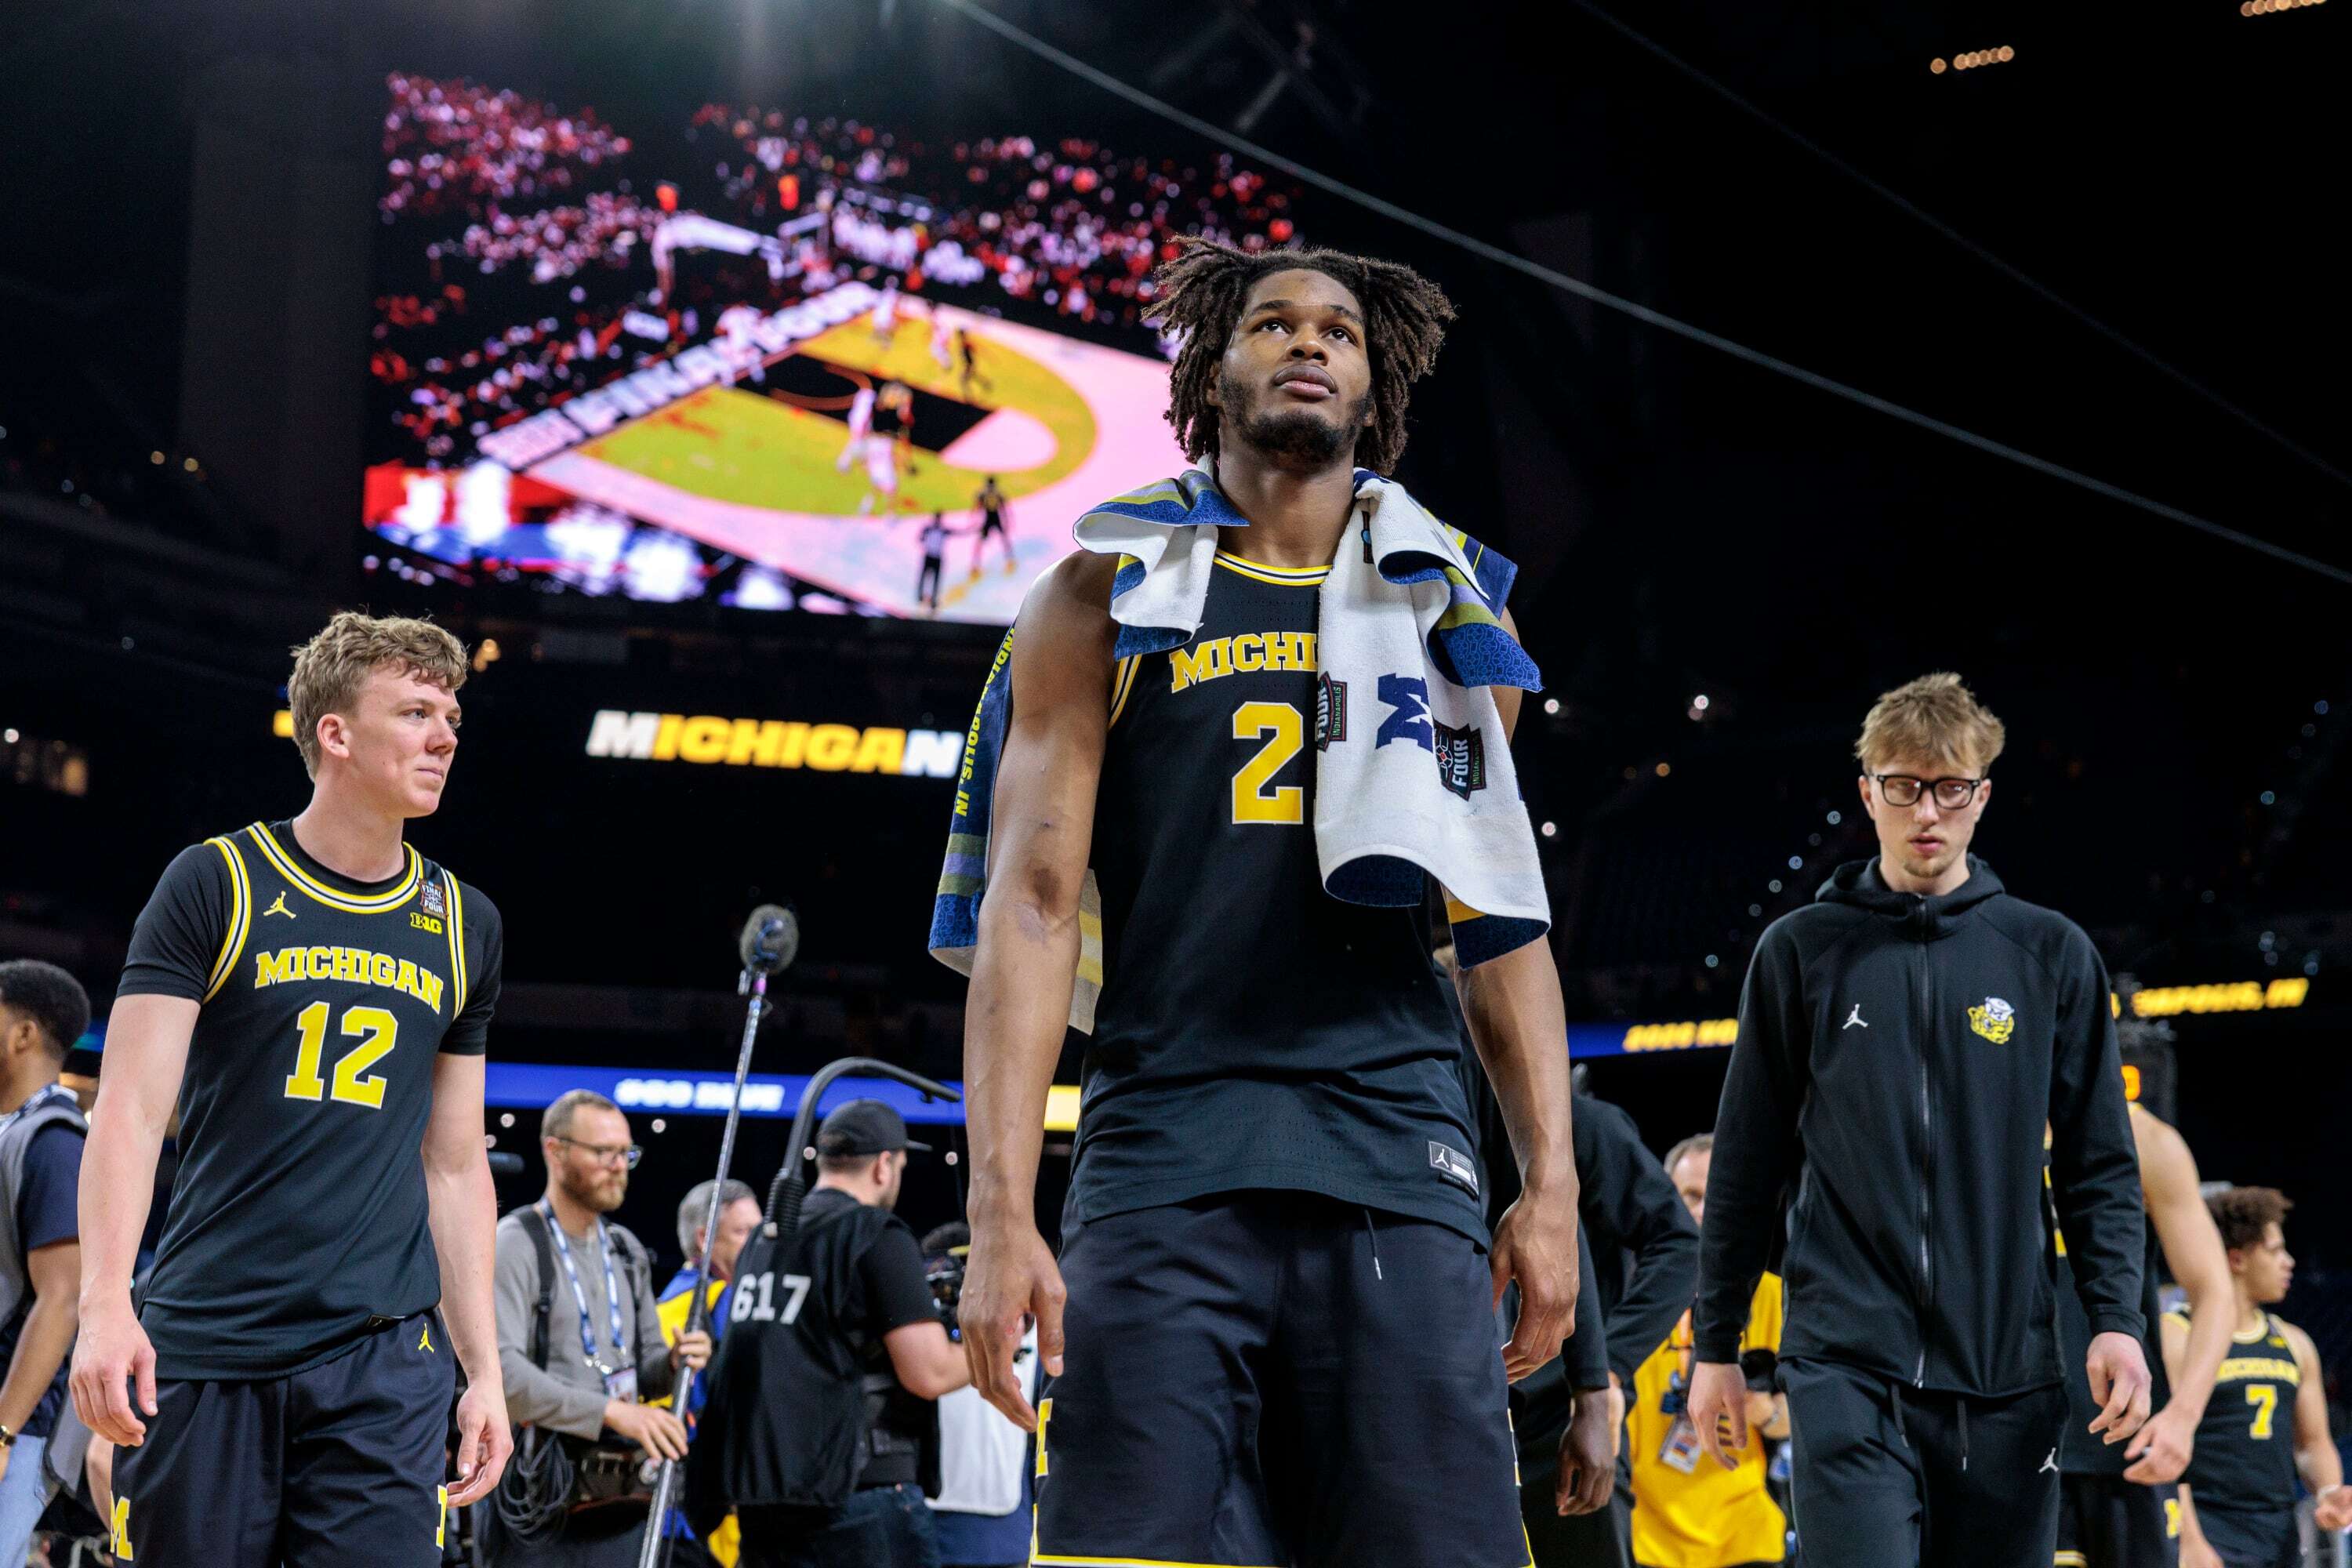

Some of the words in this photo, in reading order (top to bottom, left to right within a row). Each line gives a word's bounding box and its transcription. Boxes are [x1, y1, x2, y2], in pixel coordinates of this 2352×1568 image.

[1332, 687, 1342, 736] INDIANAPOLIS
[585, 710, 965, 779] MICHIGAN
[1232, 701, 1305, 825] 2
[1452, 739, 1469, 788] FOUR
[955, 789, 971, 818] IN
[424, 899, 445, 914] FOUR
[254, 946, 445, 1016] MICHIGAN
[284, 1000, 399, 1110] 12
[730, 1271, 812, 1325] 617
[2245, 1383, 2278, 1440] 7
[111, 1489, 133, 1562] M
